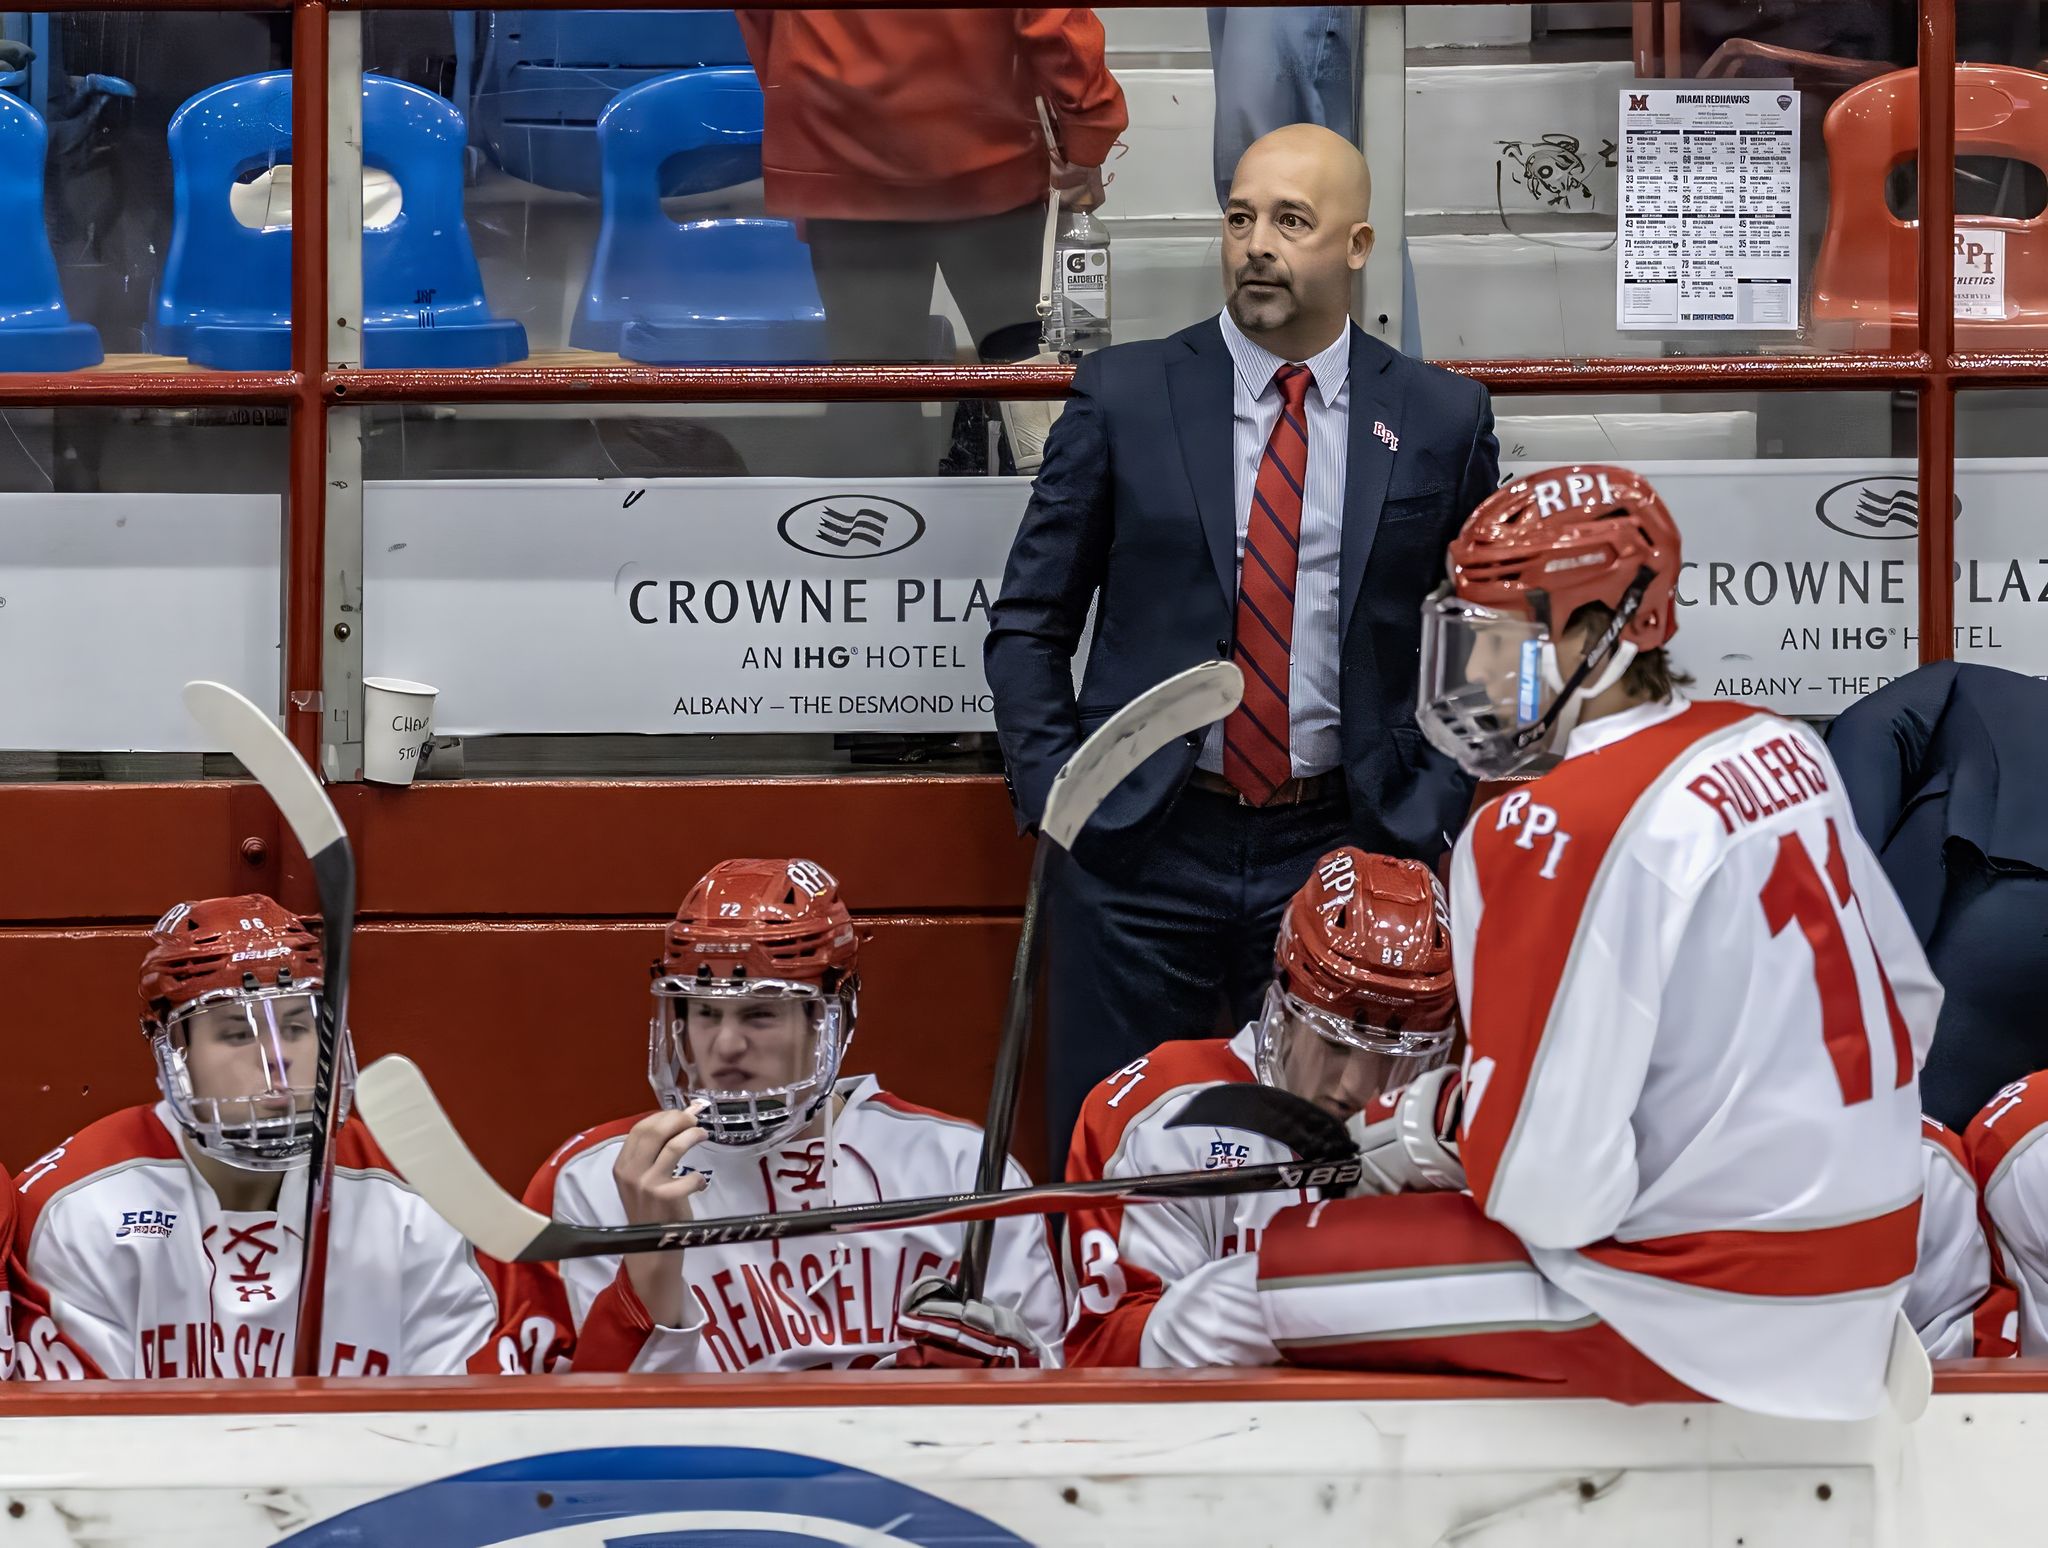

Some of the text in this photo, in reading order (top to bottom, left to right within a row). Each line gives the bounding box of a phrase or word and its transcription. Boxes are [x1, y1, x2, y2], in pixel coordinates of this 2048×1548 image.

[1676, 94, 1750, 105] MIAMI REDHAWKS
[1740, 155, 1746, 164] 17
[1625, 174, 1634, 184] 33
[1683, 175, 1689, 184] 11
[1682, 194, 1691, 204] 26
[1681, 219, 1687, 228] 9
[1739, 219, 1747, 228] 45
[1625, 239, 1632, 248] 71
[1738, 239, 1747, 248] 35
[1067, 252, 1086, 273] G
[1954, 233, 1994, 274] RPI
[1624, 259, 1629, 269] 2
[1681, 280, 1686, 289] 3
[1372, 420, 1400, 452] RPI
[1535, 472, 1616, 518] RPI
[1675, 560, 1905, 606] CROWNE
[628, 579, 868, 624] CROWNE
[1780, 628, 1820, 650] AN
[1903, 626, 2003, 650] HTEL
[741, 647, 783, 669] AN
[866, 645, 966, 669] HOTEL
[1714, 678, 1802, 696] ALBANY
[1828, 676, 1870, 695] THE
[673, 696, 764, 715] ALBANY
[789, 696, 833, 714] THE
[839, 695, 954, 714] DESMOND
[1495, 789, 1573, 880] RPI
[1318, 854, 1355, 912] RPI
[719, 902, 742, 917] 72
[239, 917, 266, 931] 86
[121, 1210, 177, 1229] ECAC
[656, 1220, 791, 1249] FLYLITE
[691, 1246, 962, 1374] RENSSEL
